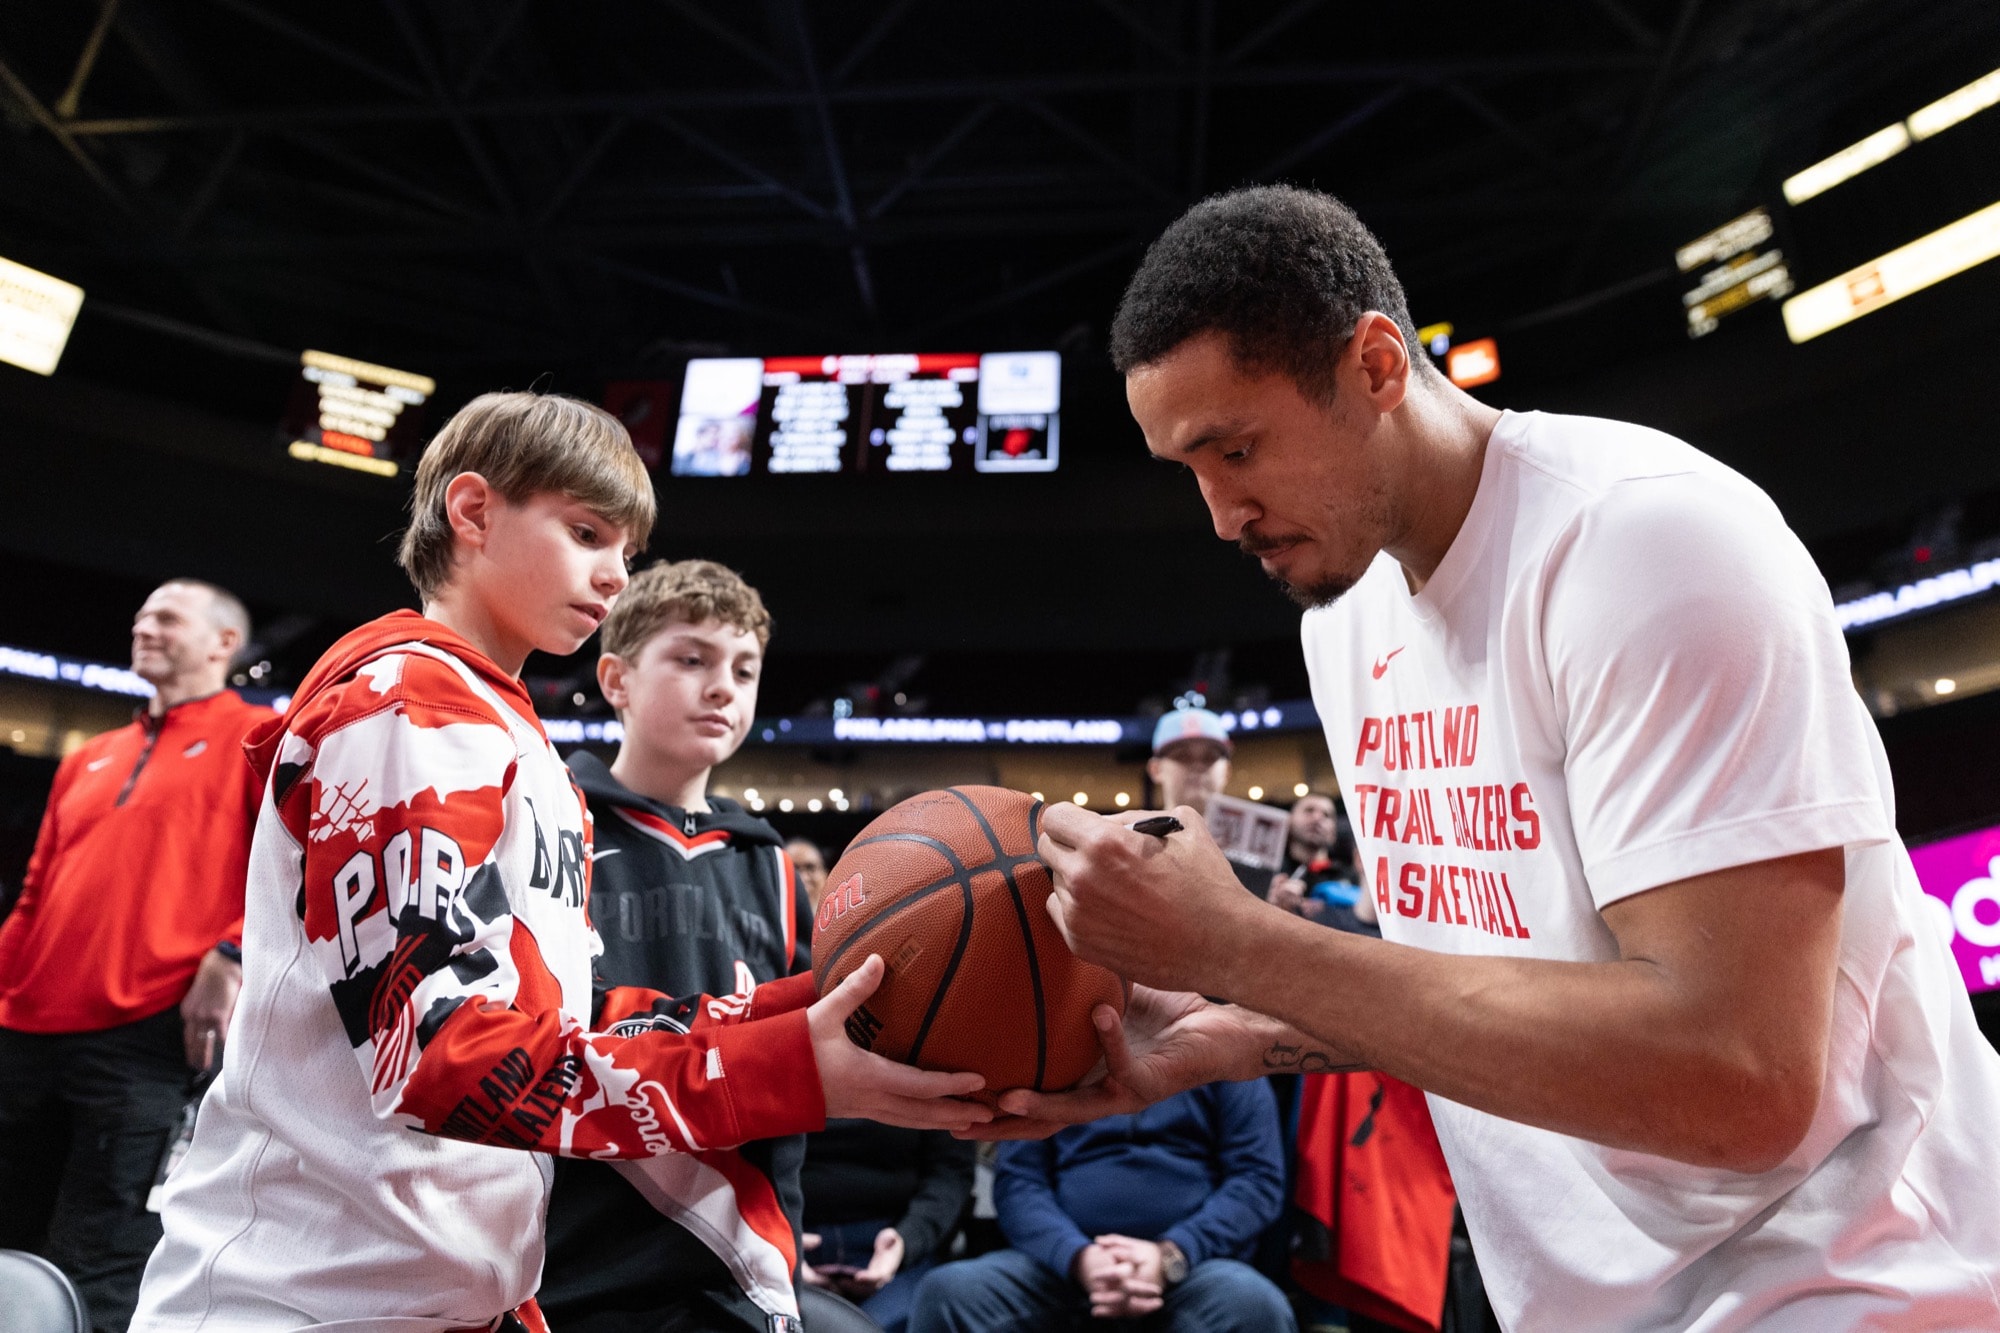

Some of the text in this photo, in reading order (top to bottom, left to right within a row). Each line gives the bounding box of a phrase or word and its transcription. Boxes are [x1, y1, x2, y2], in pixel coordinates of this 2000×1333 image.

[1355, 704, 1479, 771] PORTLND
[1355, 784, 1444, 846] TRAIL
[818, 872, 866, 932] on
[1377, 856, 1531, 939] ASKETBALL
[625, 1095, 678, 1156] ence
